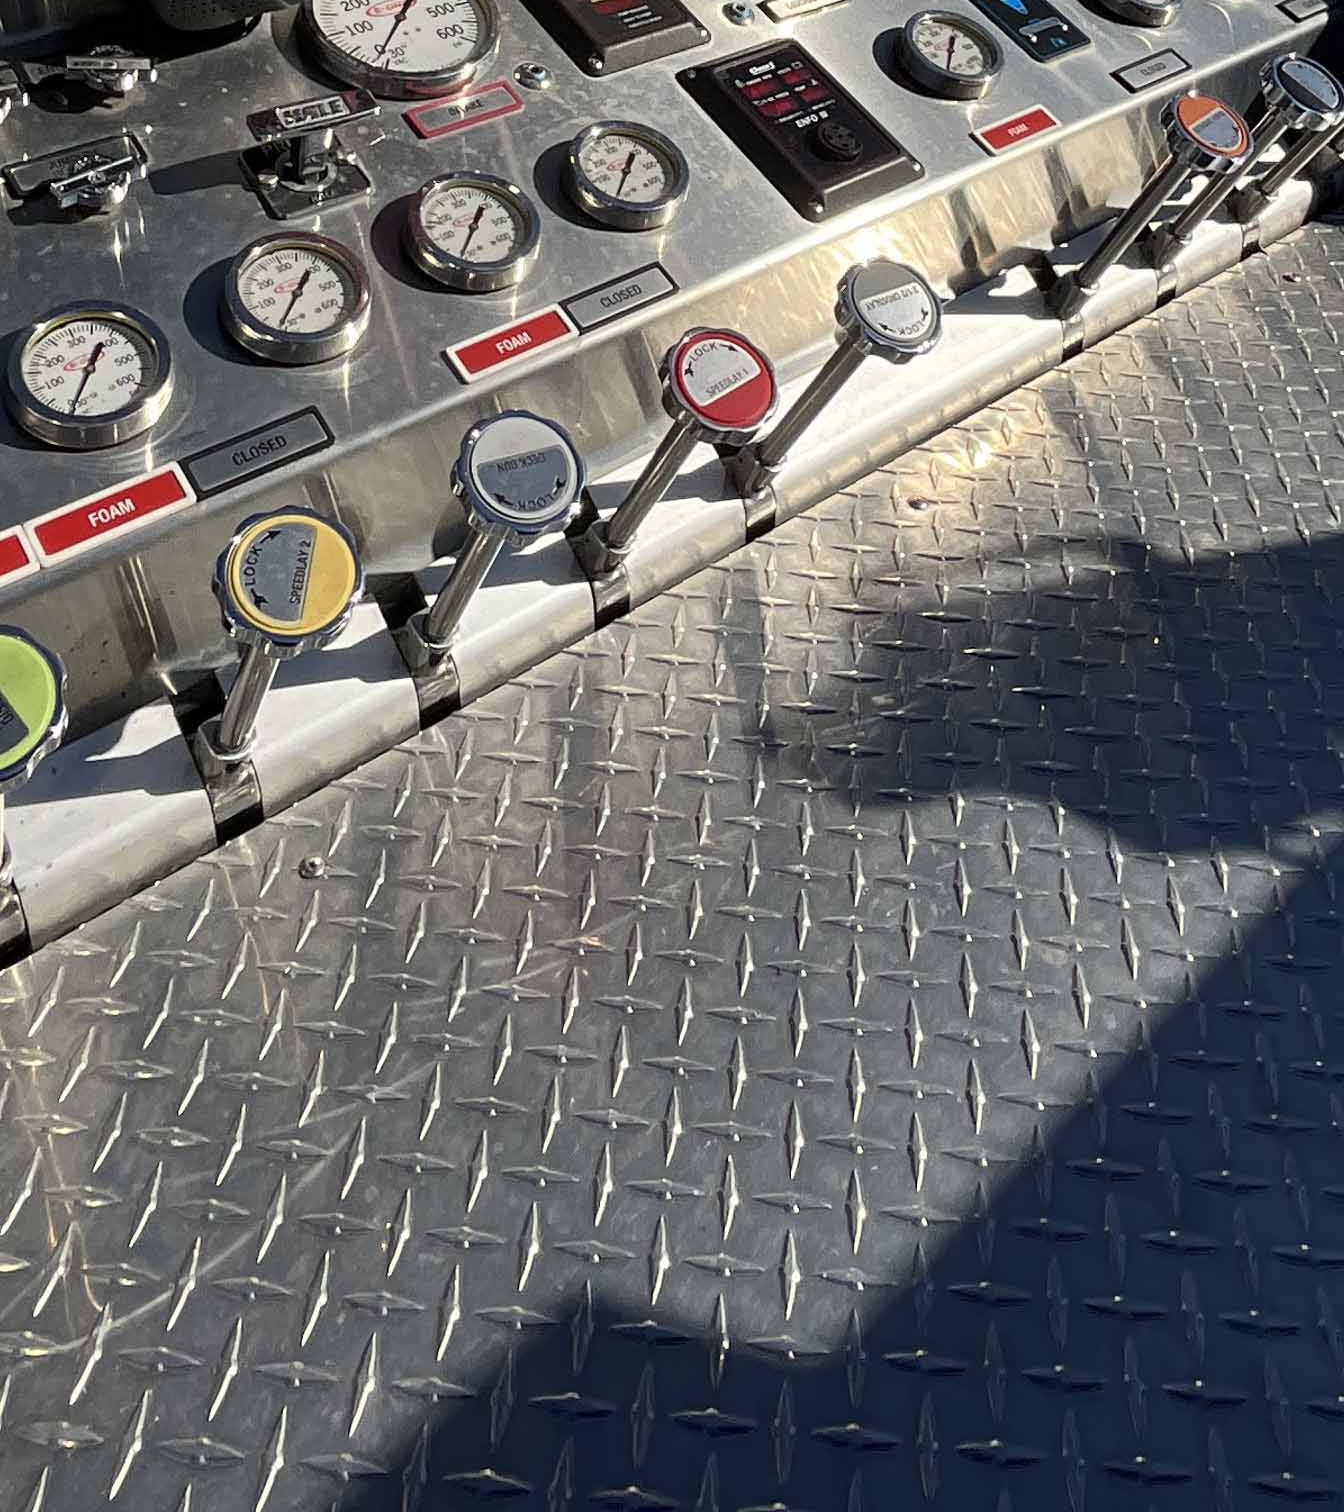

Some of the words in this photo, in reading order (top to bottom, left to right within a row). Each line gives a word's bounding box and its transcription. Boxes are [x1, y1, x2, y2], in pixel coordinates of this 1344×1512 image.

[426, 3, 455, 18] 500
[345, 21, 374, 36] 100
[436, 24, 464, 40] 600
[258, 297, 276, 309] 100
[599, 284, 642, 308] CLOSED
[896, 319, 925, 336] LOCK
[495, 332, 532, 354] FOAM
[688, 342, 720, 362] LOCK
[114, 354, 134, 366] 500
[44, 376, 65, 390] 100
[115, 374, 136, 386] 600
[705, 371, 744, 397] SPEEDLAY
[231, 435, 288, 466] CLOSED
[517, 493, 554, 511] LOCK
[87, 498, 136, 529] FOAM
[243, 545, 263, 587] LOCK
[289, 549, 309, 605] SPEEDLAY
[299, 538, 311, 548] 2
